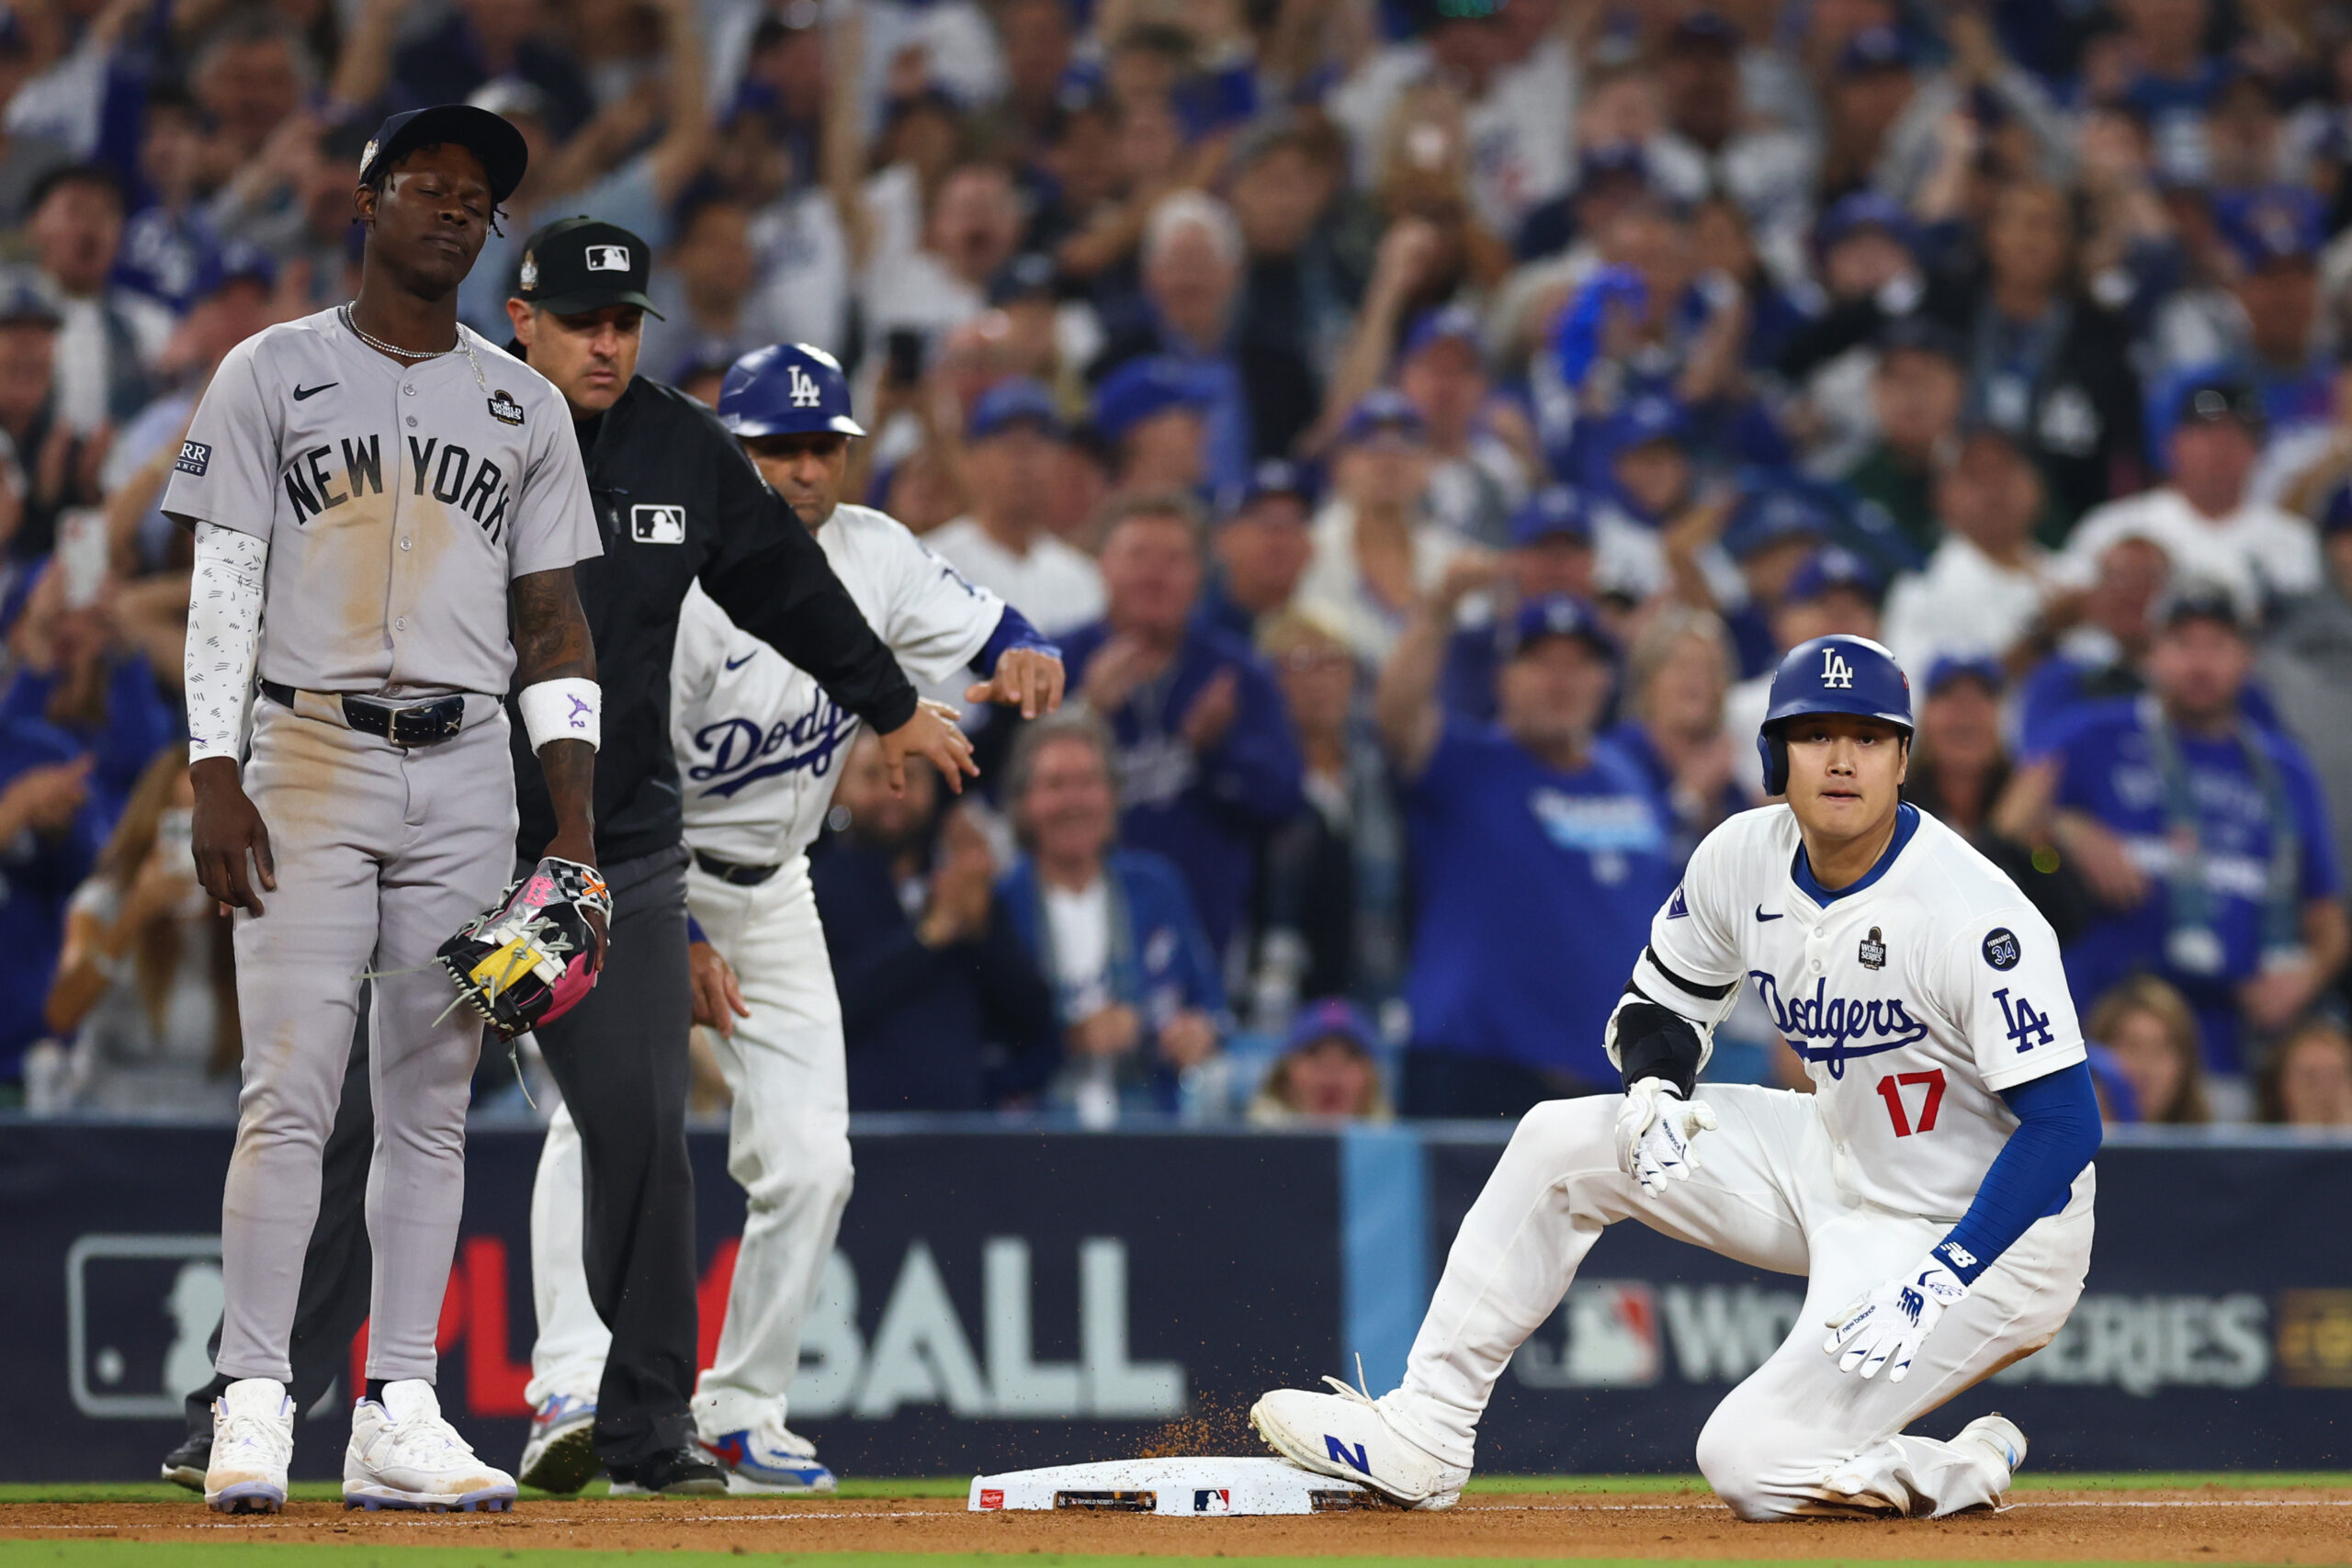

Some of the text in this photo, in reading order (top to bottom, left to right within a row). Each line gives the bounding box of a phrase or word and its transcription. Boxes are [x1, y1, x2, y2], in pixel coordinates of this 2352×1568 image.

[787, 366, 820, 407] LA
[284, 434, 510, 546] NEW YORK
[1821, 647, 1853, 688] LA
[1860, 942, 1883, 954] WORLD
[1860, 951, 1883, 962] SERIES
[1987, 933, 2011, 948] FERNANDO
[1991, 941, 2017, 965] 34
[1748, 969, 1928, 1081] Dodgers
[1992, 987, 2054, 1055] LA
[1876, 1068, 1947, 1138] 17
[1842, 1304, 1876, 1334] new balance
[1994, 1292, 2272, 1397] ERIES
[1324, 1434, 1373, 1477] N
